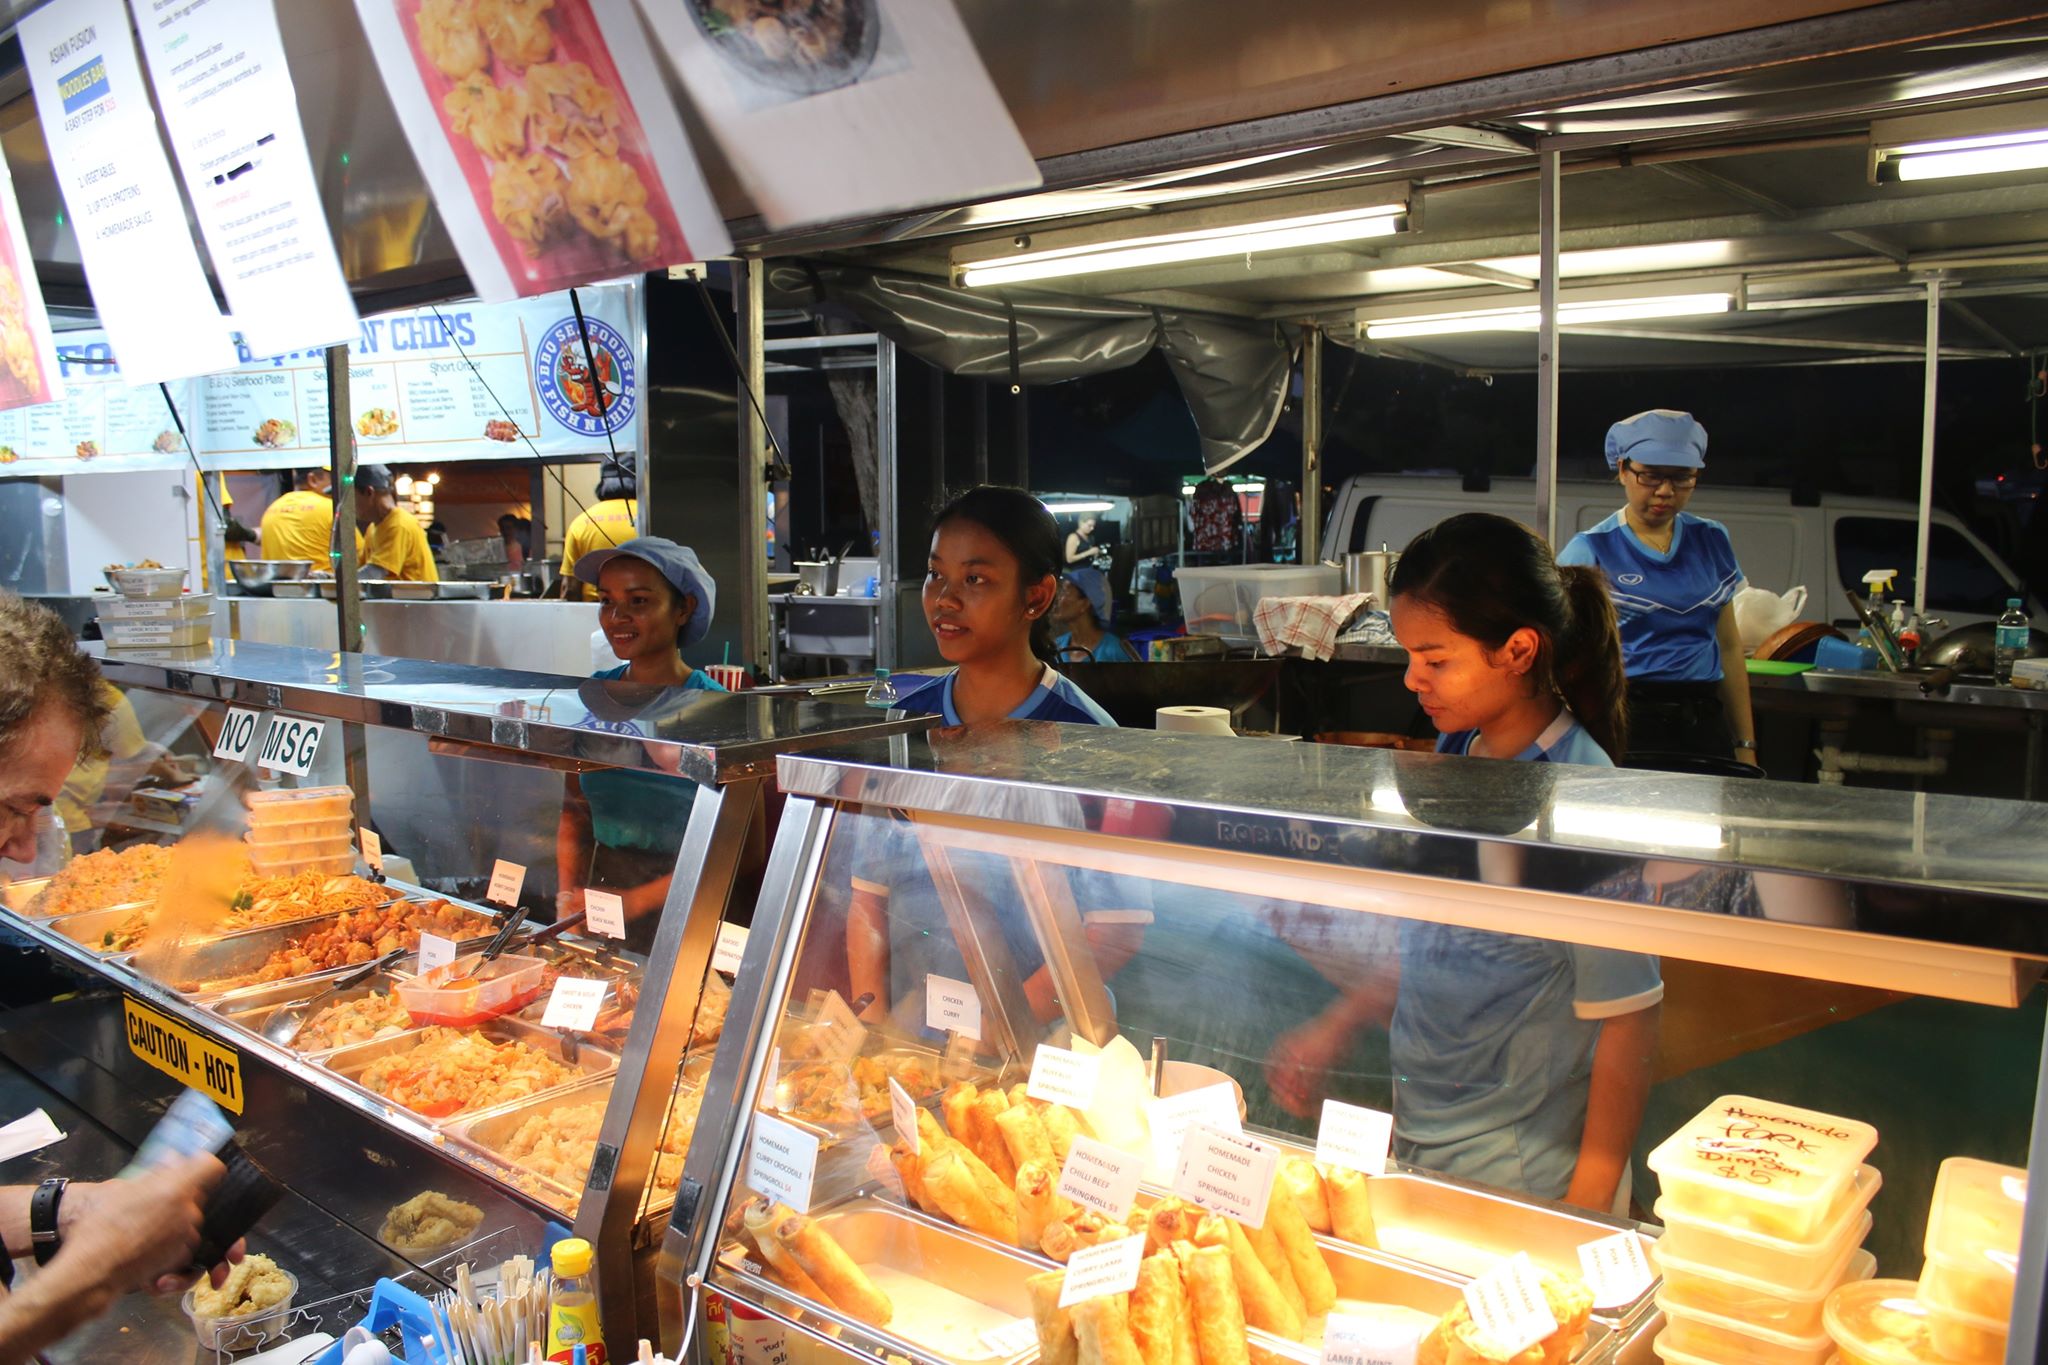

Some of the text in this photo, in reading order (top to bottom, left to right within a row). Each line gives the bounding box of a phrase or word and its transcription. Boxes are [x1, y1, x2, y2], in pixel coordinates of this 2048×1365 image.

[49, 25, 97, 66] ASIAN FUSION
[84, 163, 117, 186] VEGETABLES
[390, 312, 476, 351] CHIPS
[429, 361, 455, 374] Short
[231, 376, 264, 388] Seafood
[264, 374, 286, 385] Plate
[218, 712, 319, 769] NO MSG
[942, 995, 964, 1006] CHICKEN
[943, 1009, 960, 1019] CURRY
[128, 1011, 190, 1075] CAUTION
[203, 1050, 236, 1100] HOT
[1722, 1106, 1851, 1140] Homemade
[759, 1135, 790, 1155] HOMEMADE
[1208, 1144, 1252, 1168] HOMEMADE
[756, 1152, 803, 1180] CURRY CROCODILE
[1075, 1149, 1121, 1175] HOMEMADE
[1696, 1149, 1757, 1168] Dim
[753, 1168, 784, 1190] SPRINGROLL
[1069, 1166, 1111, 1190] CHILLI BEEF
[1207, 1164, 1238, 1182] CHICKEN
[1062, 1183, 1107, 1209] SPRINGROLL
[1197, 1180, 1241, 1203] SPRINGROLL
[1327, 1353, 1354, 1364] LAMB
